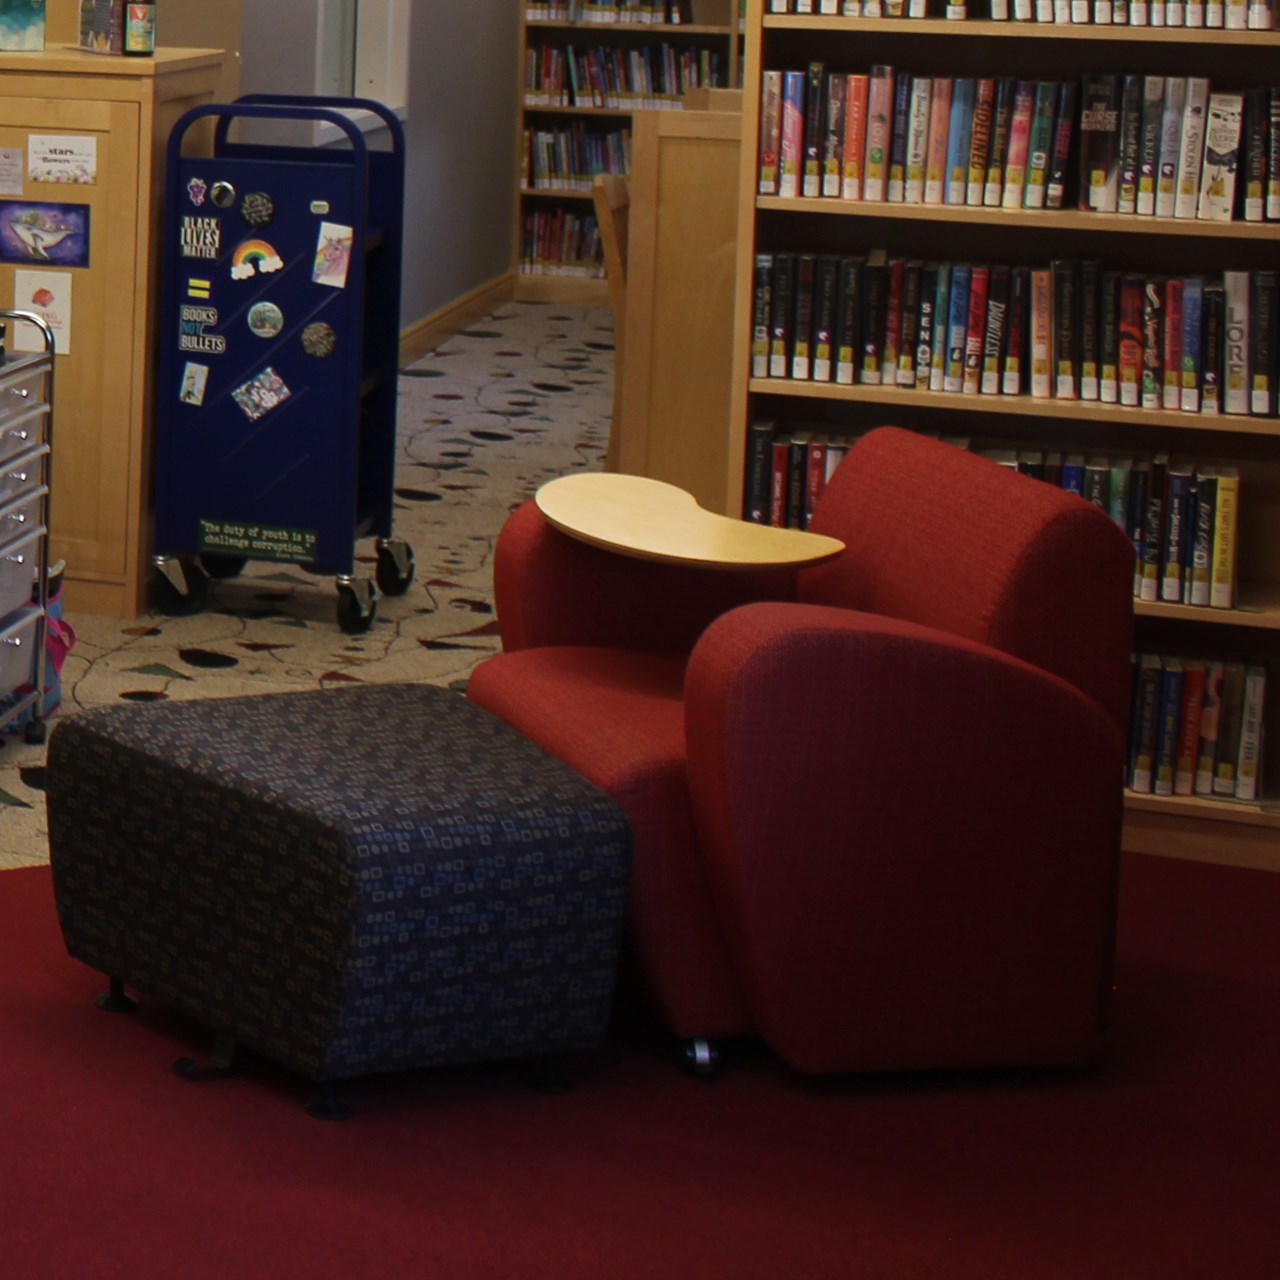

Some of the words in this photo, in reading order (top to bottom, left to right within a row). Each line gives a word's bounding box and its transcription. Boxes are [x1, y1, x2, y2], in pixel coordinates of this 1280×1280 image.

[1083, 111, 1119, 123] CURSE
[970, 100, 992, 169] SIDELINED
[48, 148, 75, 156] stars
[183, 216, 218, 231] BLACK
[181, 227, 220, 249] LIVES
[183, 244, 217, 259] MATTER
[182, 307, 217, 322] BOOKS
[985, 300, 1006, 357] DAUNTLESS
[180, 334, 224, 351] BULLETS
[223, 525, 245, 537] duty
[262, 530, 289, 541] youth
[204, 535, 249, 549] challenge
